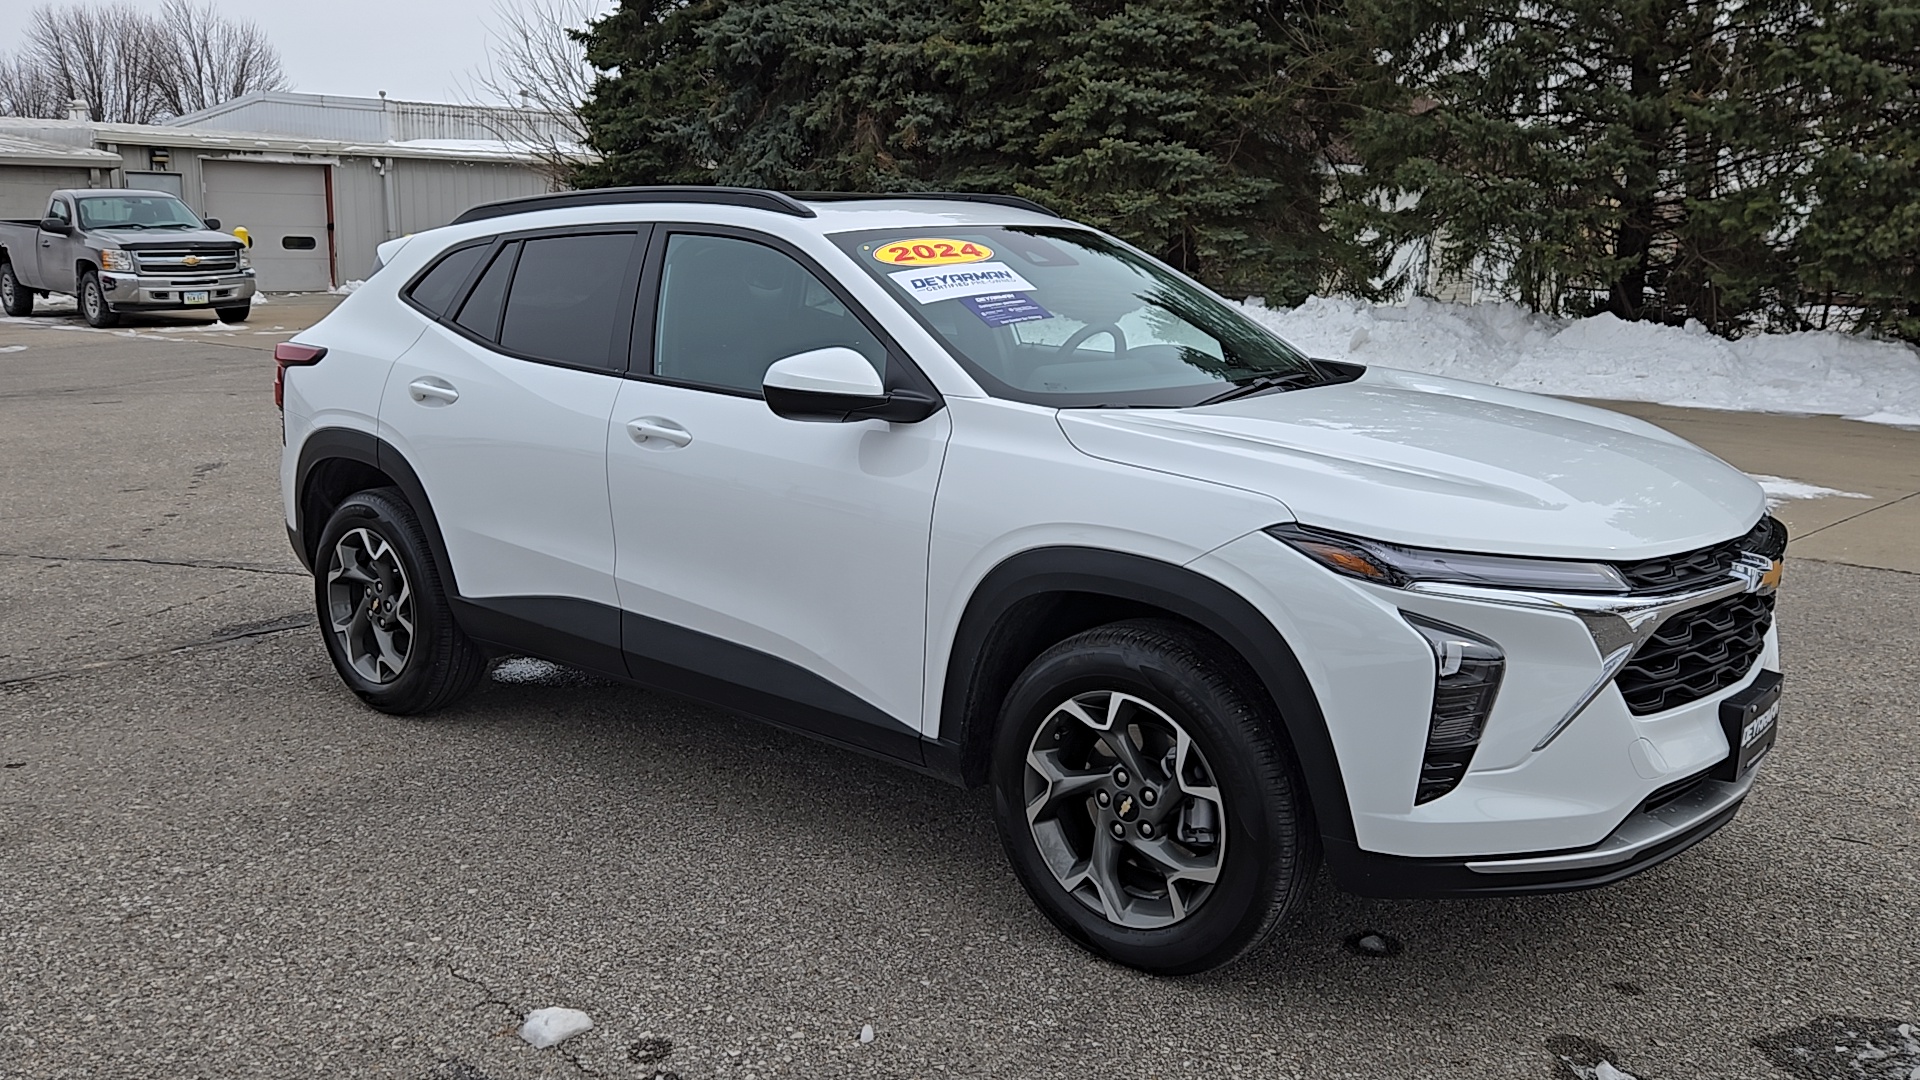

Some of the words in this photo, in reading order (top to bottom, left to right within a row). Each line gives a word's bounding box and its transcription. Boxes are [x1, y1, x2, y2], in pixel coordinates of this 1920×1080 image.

[889, 244, 982, 262] 2024
[910, 271, 1012, 289] DEYARMAN
[926, 282, 970, 292] CERTIFIED
